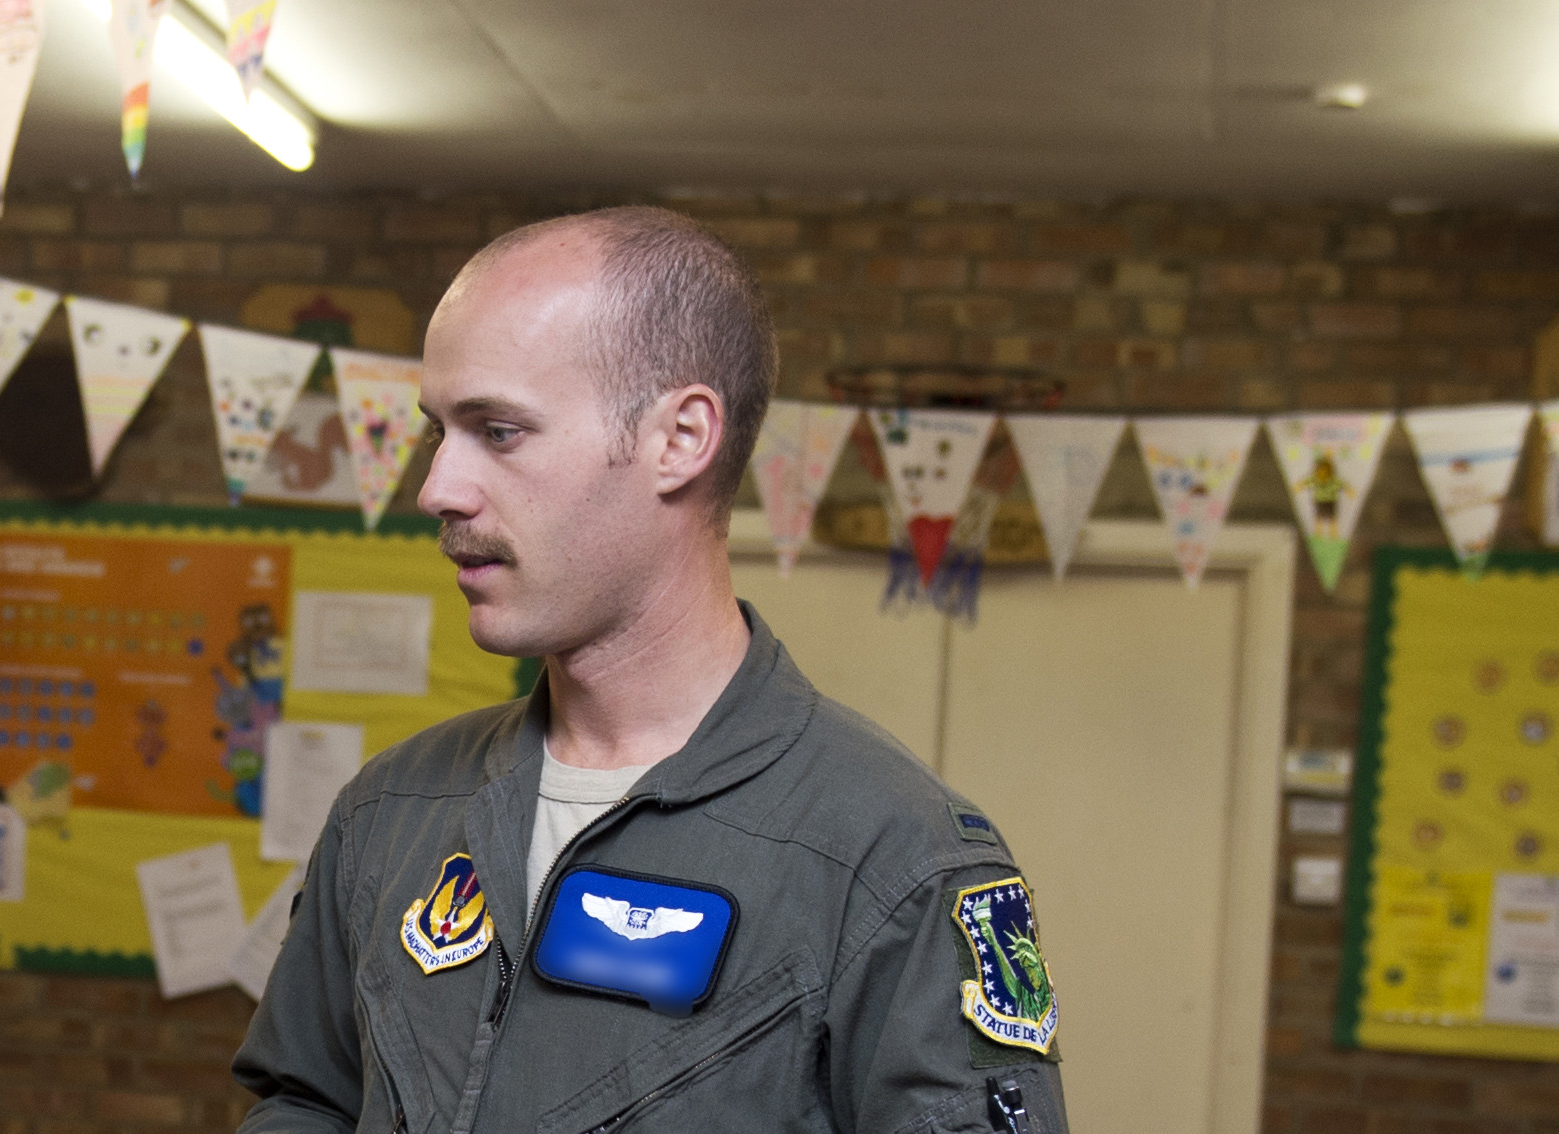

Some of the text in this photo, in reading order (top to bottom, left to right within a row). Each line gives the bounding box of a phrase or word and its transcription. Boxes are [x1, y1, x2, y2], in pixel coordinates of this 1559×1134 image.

[452, 936, 485, 961] EUROPE
[974, 1004, 1021, 1039] STATUE
[1023, 1025, 1037, 1043] DE
